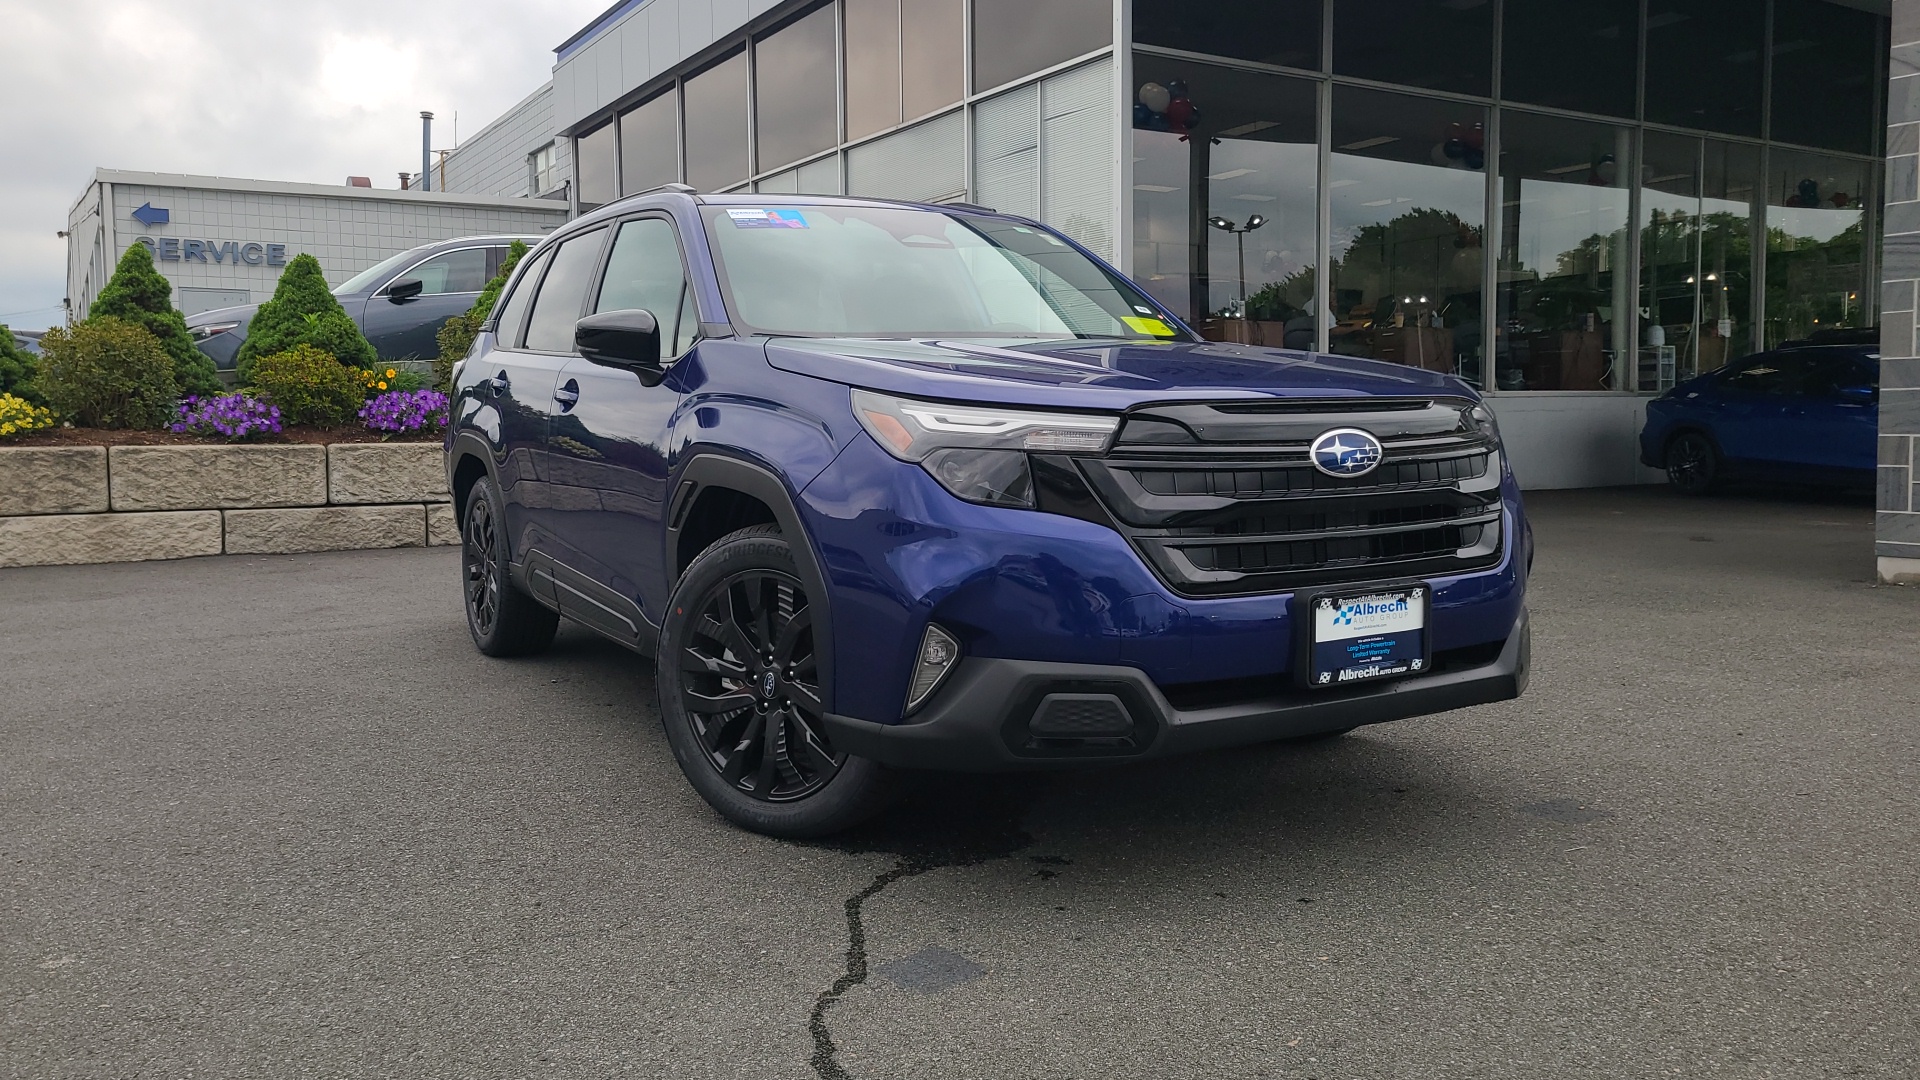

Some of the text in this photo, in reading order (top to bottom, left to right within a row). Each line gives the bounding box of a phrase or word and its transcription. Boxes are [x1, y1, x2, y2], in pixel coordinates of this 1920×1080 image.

[1354, 601, 1408, 616] Albrecht
[1354, 612, 1409, 624] AUTO GROUP
[1347, 643, 1370, 652] Long-Term
[1371, 640, 1395, 648] Powertrain
[1352, 648, 1391, 659] Limited Warranty
[1338, 666, 1380, 681] Albrecht
